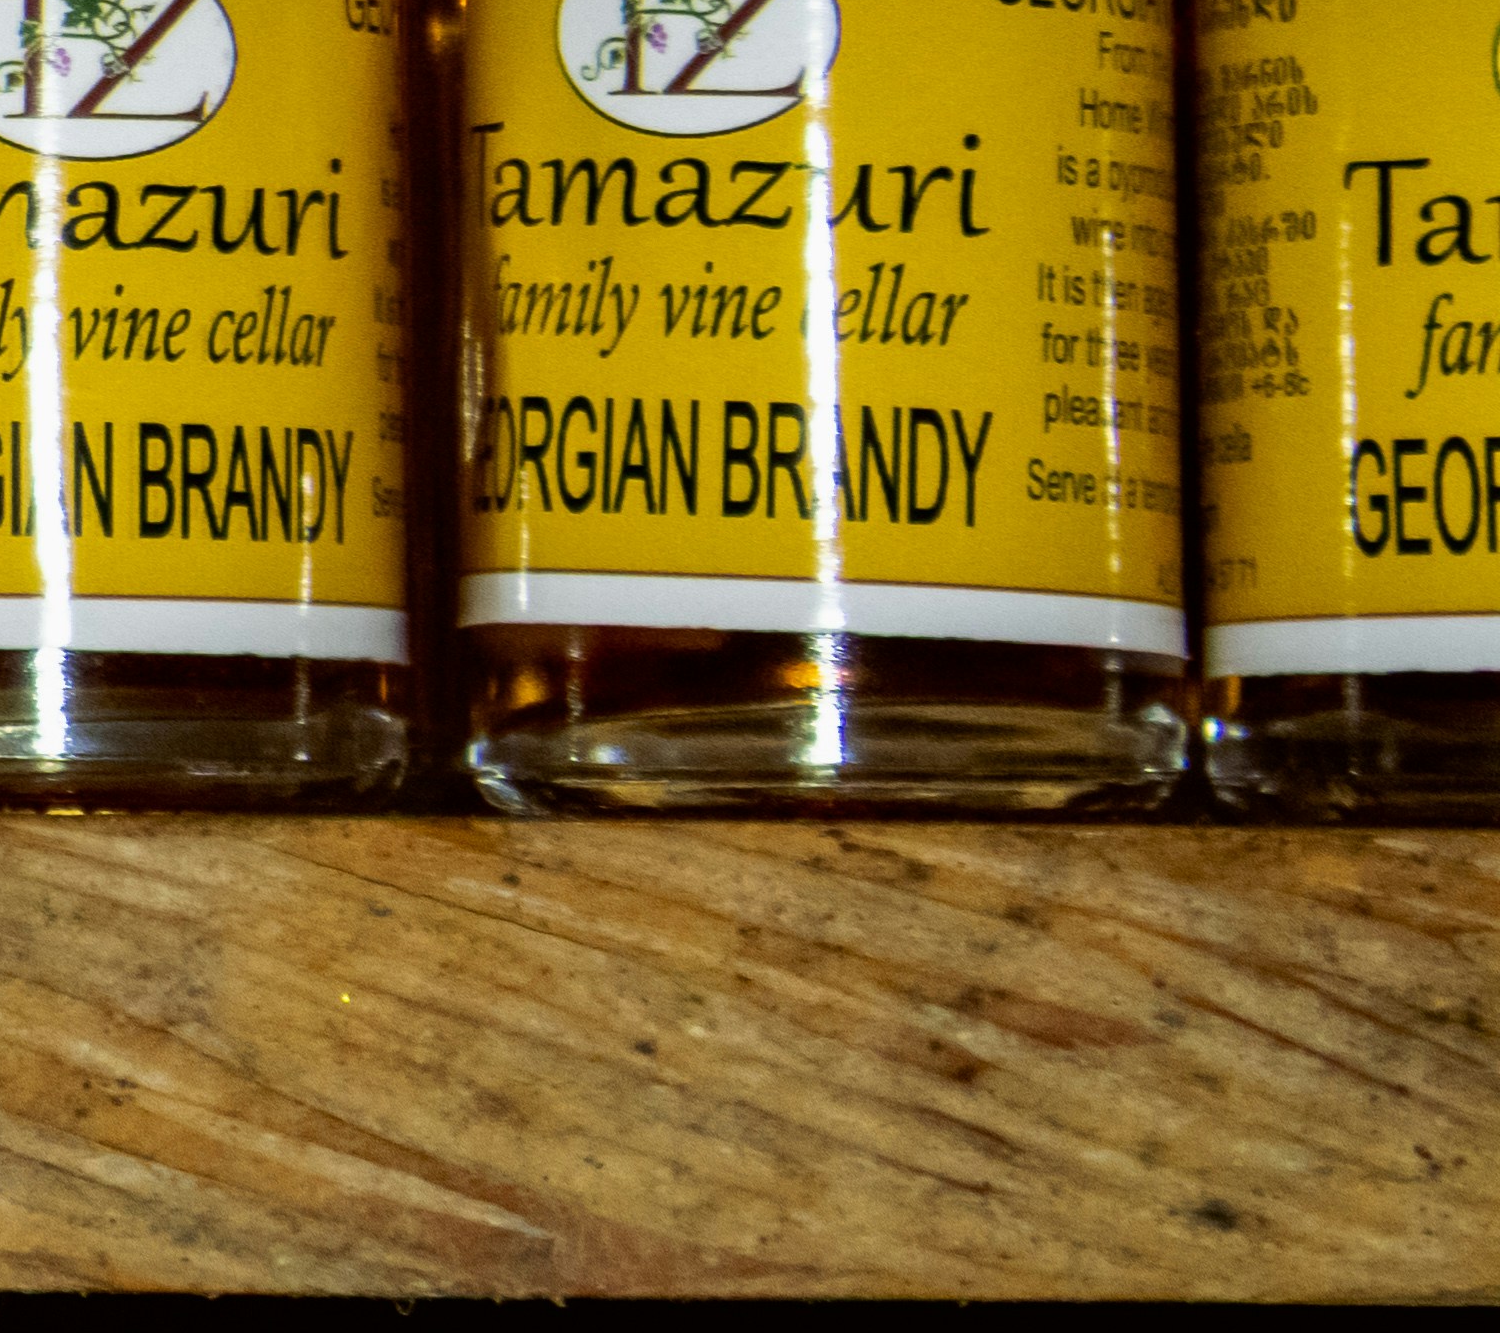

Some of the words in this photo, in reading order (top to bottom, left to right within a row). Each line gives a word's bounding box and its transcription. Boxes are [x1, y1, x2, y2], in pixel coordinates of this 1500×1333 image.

[472, 120, 992, 238] Tamazuri
[1056, 145, 1078, 187] is
[1085, 156, 1100, 189] a
[660, 260, 783, 341] vine
[800, 262, 970, 346] ellar
[1037, 262, 1056, 303] It
[1063, 264, 1085, 307] is
[1090, 269, 1139, 312] ten
[67, 282, 192, 364] vine
[208, 284, 338, 368] cellar
[1041, 321, 1079, 365] for
[1086, 326, 1141, 371] thee
[1043, 384, 1143, 434] pleaant
[138, 422, 355, 546] BRANDY
[473, 394, 701, 516] EORGIAN
[721, 399, 994, 528] BRANDY
[1026, 457, 1096, 505] Serve
